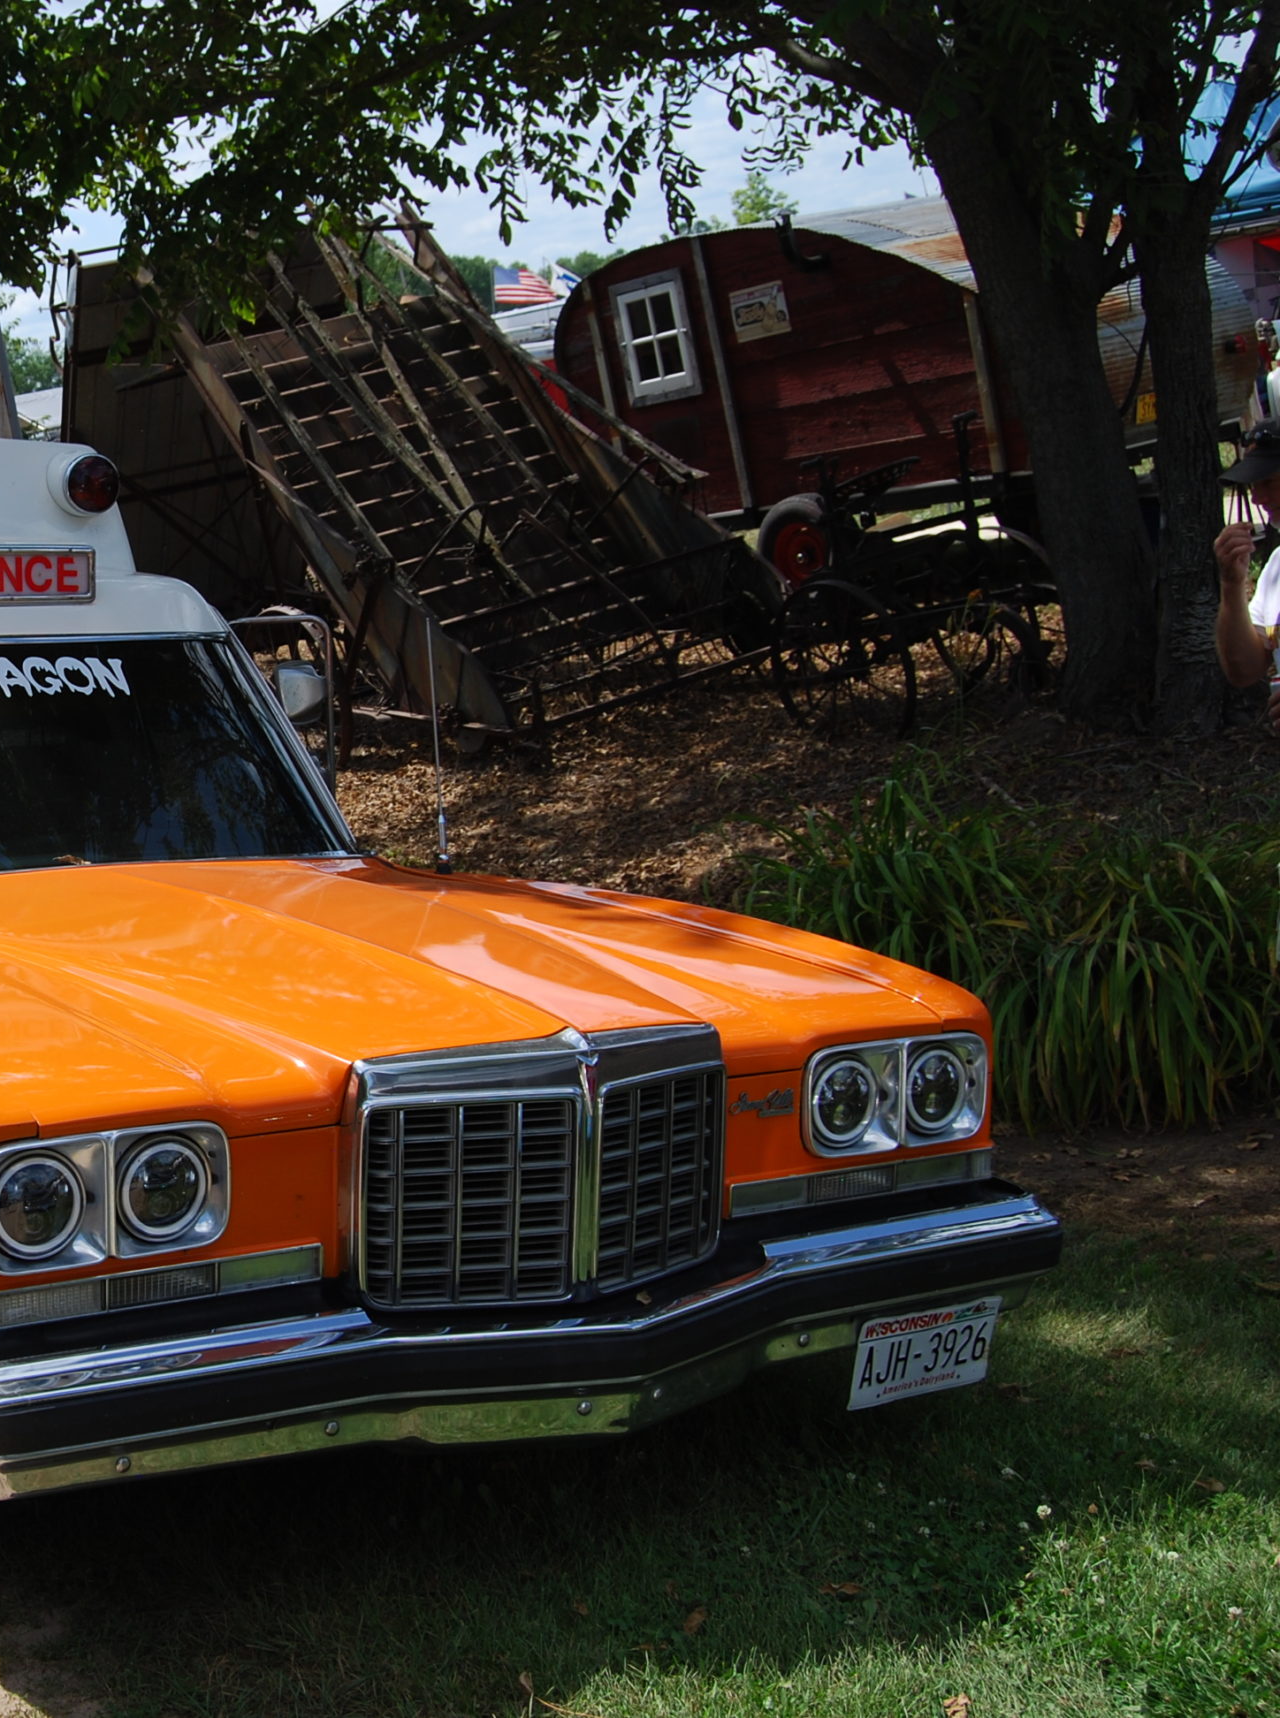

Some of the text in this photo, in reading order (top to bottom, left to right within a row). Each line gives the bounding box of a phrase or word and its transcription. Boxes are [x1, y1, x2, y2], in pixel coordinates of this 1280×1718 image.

[865, 1312, 943, 1339] WISCONSIN
[859, 1321, 988, 1389] AJH-3926
[882, 1371, 956, 1395] America's Dairyland
